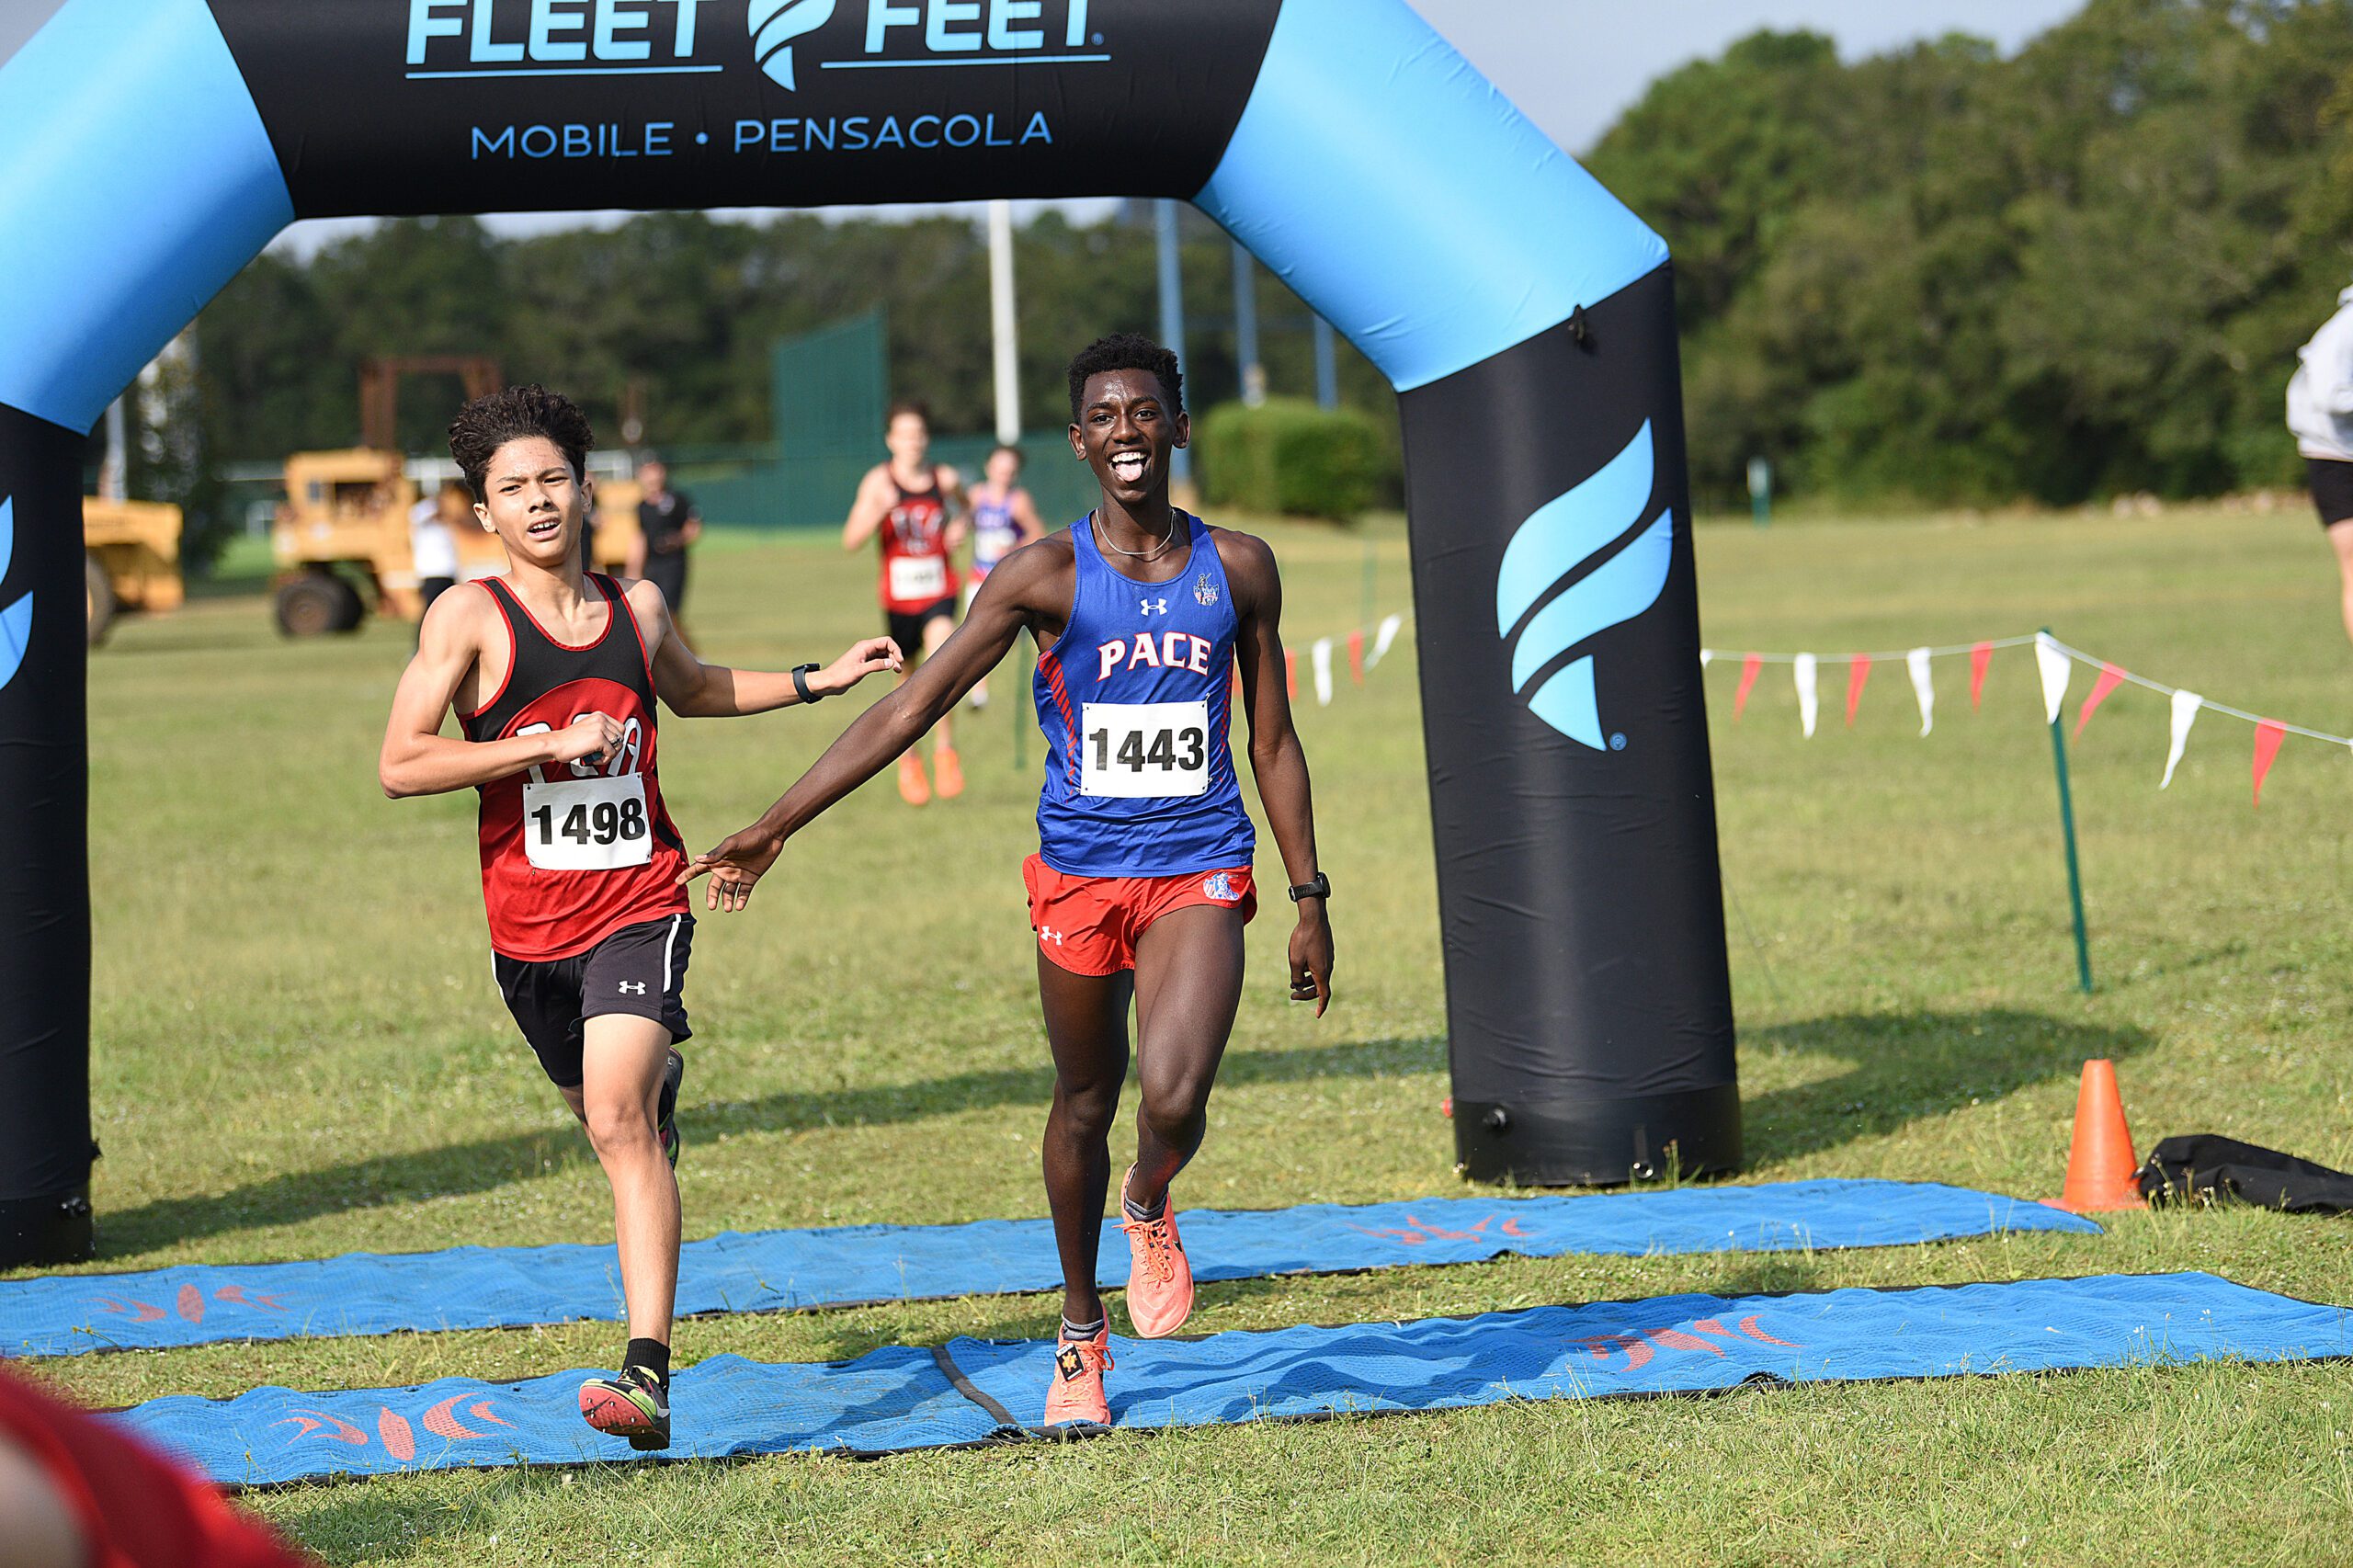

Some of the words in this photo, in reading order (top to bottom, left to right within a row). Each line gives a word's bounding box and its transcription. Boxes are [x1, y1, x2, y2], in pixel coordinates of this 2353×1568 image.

[471, 121, 675, 160] MOBILE
[734, 111, 1053, 153] PENSACOLA
[1096, 628, 1212, 683] PACE
[1088, 726, 1205, 772] 1443
[530, 797, 646, 846] 1498
